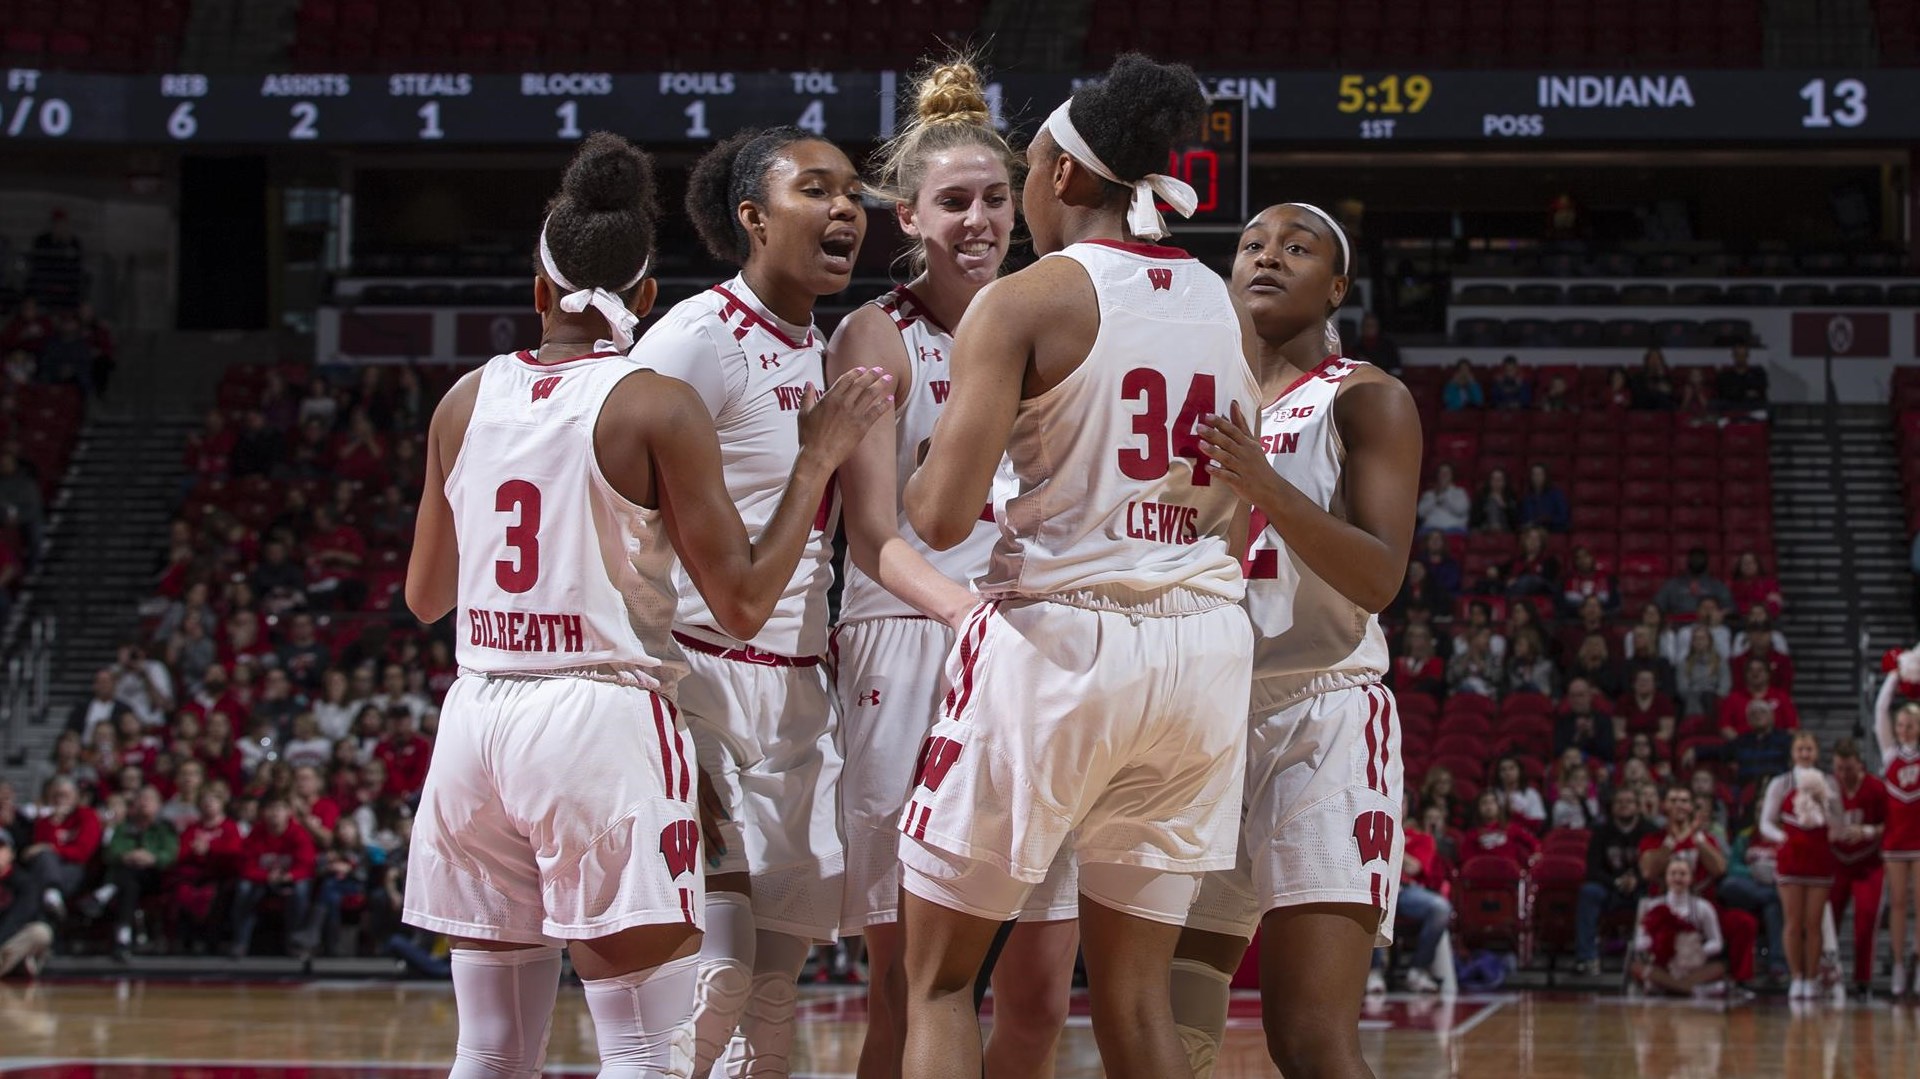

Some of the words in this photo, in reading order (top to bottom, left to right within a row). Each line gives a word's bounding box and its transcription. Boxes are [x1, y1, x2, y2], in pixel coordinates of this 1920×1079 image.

[7, 68, 41, 92] FT
[161, 74, 208, 97] REB
[261, 74, 350, 96] ASSISTS
[389, 73, 472, 96] STEALS
[521, 73, 613, 96] BLOCKS
[659, 72, 736, 95] FOULS
[790, 71, 839, 95] TOL
[1338, 75, 1432, 113] 5:19
[1538, 75, 1694, 107] INDIANA
[0, 96, 71, 136] /0
[168, 102, 197, 139] 6
[290, 102, 318, 139] 2
[418, 101, 444, 139] 1
[557, 101, 582, 138] 1
[685, 100, 709, 138] 1
[797, 100, 826, 136] 4
[1800, 79, 1867, 127] 13
[1359, 118, 1396, 139] 1ST
[1483, 114, 1544, 136] POSS
[1118, 368, 1217, 486] 34
[495, 479, 542, 594] 3
[1126, 501, 1199, 545] LEWIS
[469, 608, 584, 652] GILREATH
